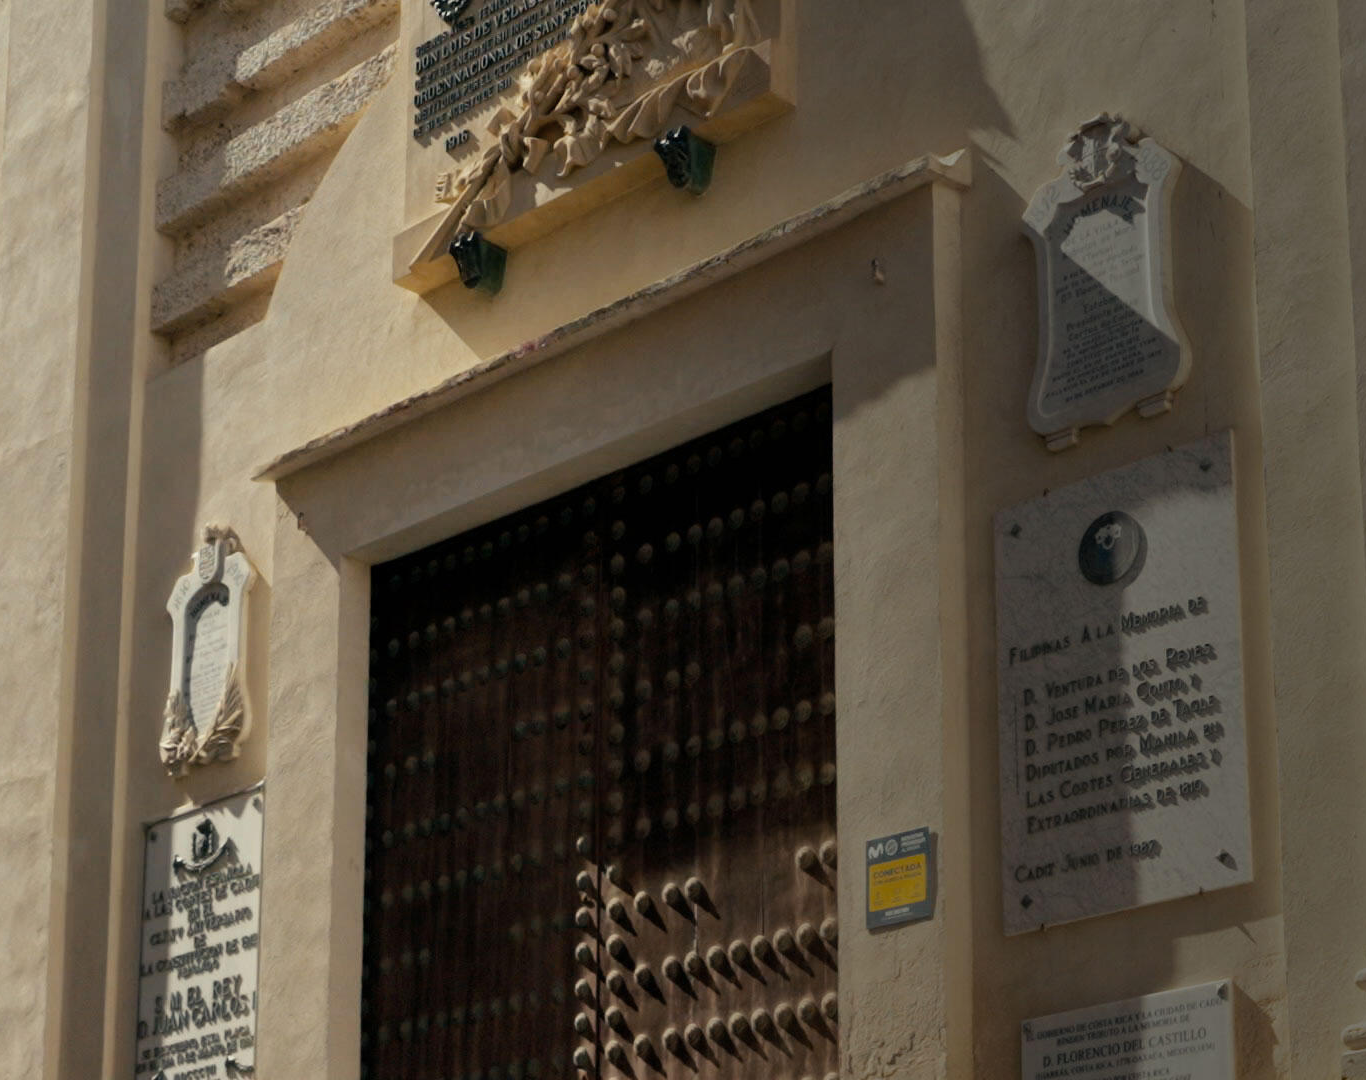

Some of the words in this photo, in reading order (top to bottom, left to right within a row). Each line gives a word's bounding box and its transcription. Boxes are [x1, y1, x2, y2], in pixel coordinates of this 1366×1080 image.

[414, 77, 452, 107] ORDEN
[451, 45, 514, 89] NACIONAL
[515, 30, 534, 52] DE
[534, 13, 561, 42] SAN
[415, 51, 439, 74] DON
[441, 31, 473, 60] LUIS
[473, 20, 492, 41] DE
[1009, 636, 1070, 666] FILIPINAS
[1081, 626, 1091, 643] A
[1096, 624, 1114, 640] LA
[1122, 603, 1185, 630] MEMORIA
[1188, 596, 1207, 614] DE
[1023, 688, 1037, 706] D.
[1045, 675, 1102, 699] VENTURA
[1108, 664, 1124, 683] DE
[1132, 659, 1157, 680] LOS
[1166, 643, 1213, 670] REYES
[1024, 714, 1038, 732] D.
[1046, 706, 1078, 725] JOSE
[1085, 693, 1131, 715] MARIA
[1025, 738, 1038, 757] D.
[1047, 728, 1091, 752] PEDRO
[1099, 715, 1146, 738] PEREZ
[1151, 708, 1168, 725] DE
[1173, 694, 1216, 718] TAGLE
[1026, 751, 1099, 782] DIPUTADOS
[1106, 744, 1134, 763] POR
[1139, 728, 1196, 754] MANILA
[1203, 721, 1224, 739] EN
[1027, 790, 1054, 809] LAS
[1060, 776, 1112, 799] CORTES
[1120, 751, 1207, 785] GENERALES
[1027, 792, 1151, 834] EXTRAORDINARIAS
[1156, 786, 1175, 804] DE
[1015, 862, 1054, 884] CADIZ
[1060, 852, 1100, 873] JUNIO
[1107, 847, 1123, 862] DE
[1129, 840, 1158, 859] 1987
[153, 900, 174, 920] LAS
[215, 885, 229, 900] DE
[187, 905, 254, 937] ANIVERSARIO
[156, 943, 223, 974] CONSTITUCION
[195, 935, 207, 950] DE
[187, 985, 205, 1007] EL
[213, 974, 244, 1000] REY
[154, 1005, 191, 1036] JUAN
[191, 993, 251, 1029] CARLOS
[1037, 1024, 1075, 1040] GOBIERNO
[1076, 1022, 1087, 1033] DE
[1088, 1017, 1113, 1031] COSTA
[1115, 1014, 1133, 1026] RICA
[1142, 1010, 1152, 1020] LA
[1155, 1004, 1185, 1018] CIUDAD
[1187, 1002, 1197, 1012] DE
[1087, 1026, 1120, 1041] TRIBUTO
[1129, 1022, 1140, 1033] LA
[1141, 1015, 1178, 1031] MEMORIA
[1180, 1013, 1190, 1023] DE
[1057, 1042, 1121, 1066] FLORENCIO
[1123, 1038, 1144, 1054] DEL
[1149, 1027, 1206, 1049] CASTILLO
[1071, 1062, 1095, 1074] COSTA
[1128, 1068, 1151, 1080] COSTA
[1153, 1065, 1169, 1076] RICA
